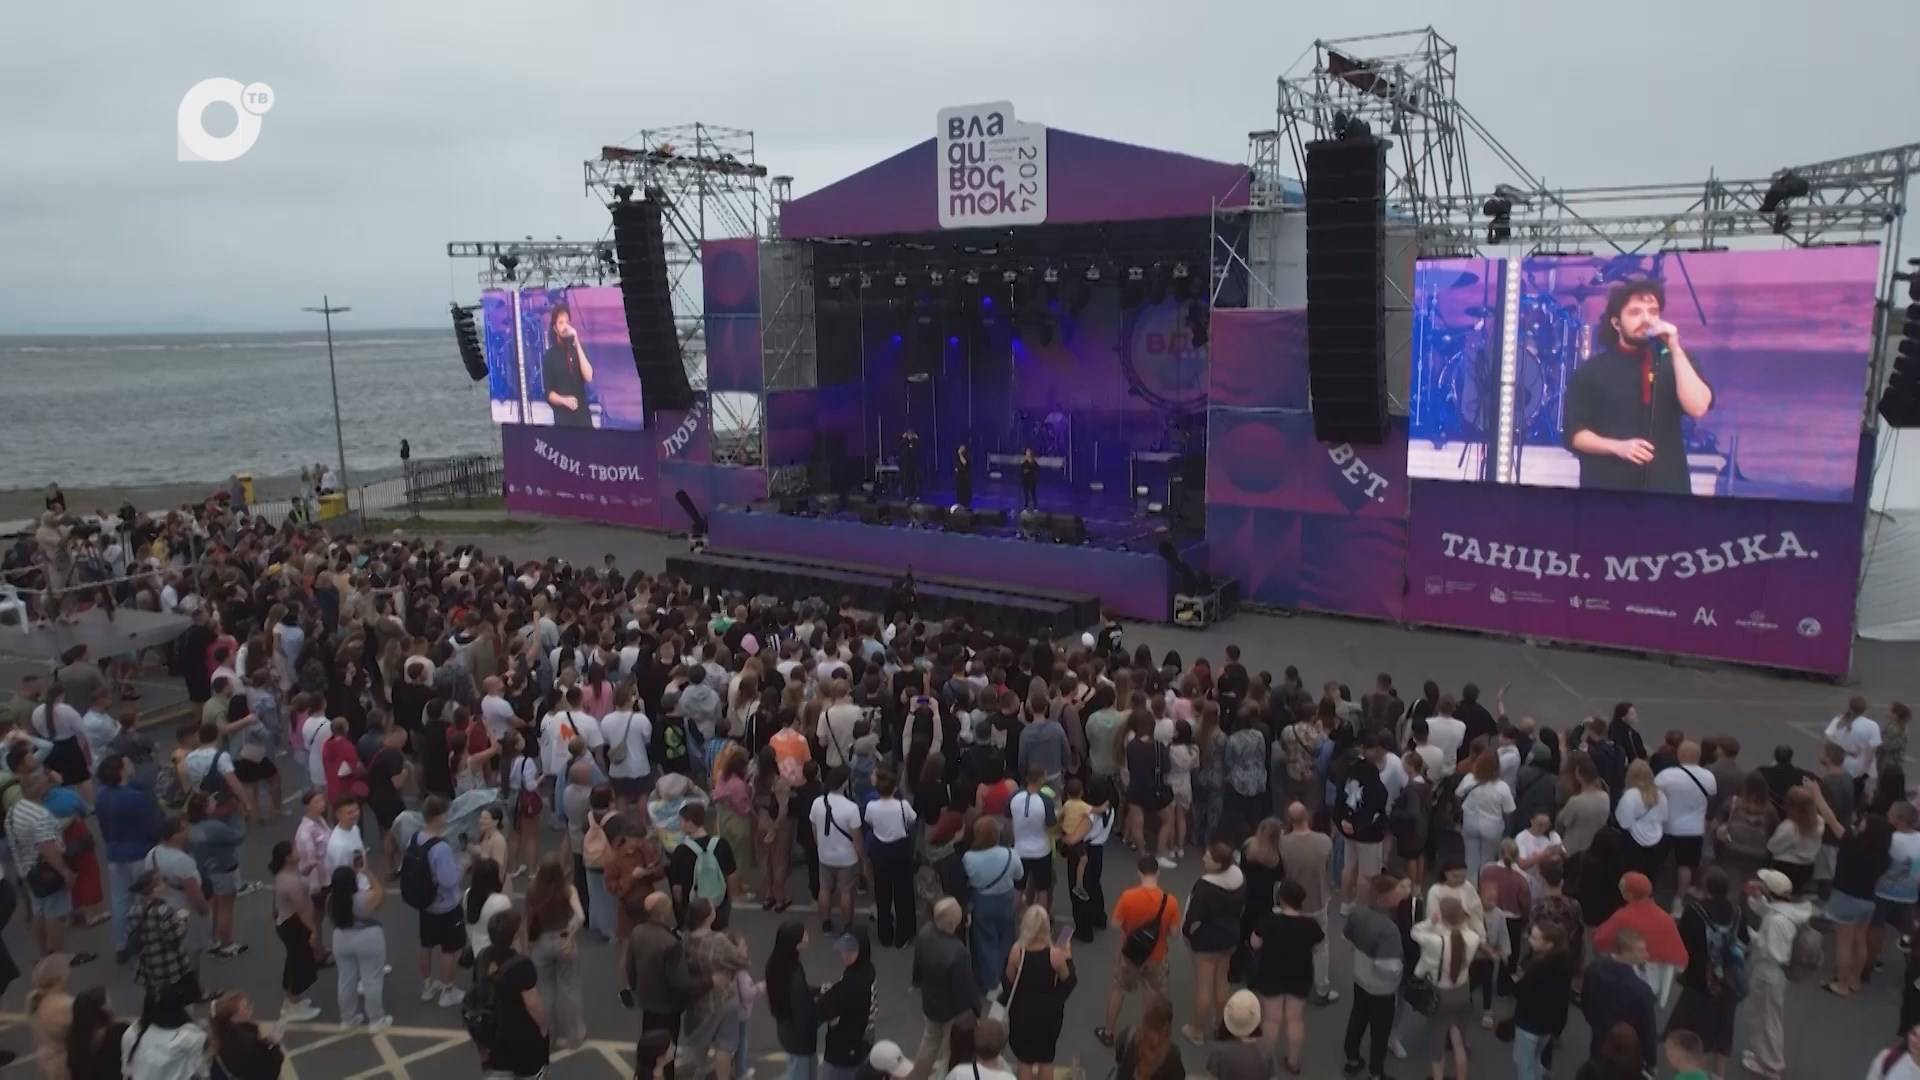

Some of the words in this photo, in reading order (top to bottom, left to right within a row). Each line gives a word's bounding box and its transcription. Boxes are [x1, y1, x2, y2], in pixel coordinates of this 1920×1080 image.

[1018, 145, 1038, 212] 2024
[534, 438, 584, 477] ЖИВИ.
[588, 464, 644, 481] ТВОРИ.
[1442, 532, 1591, 580] ТАНЦЫ.
[1604, 530, 1819, 582] МУЗЫКА.
